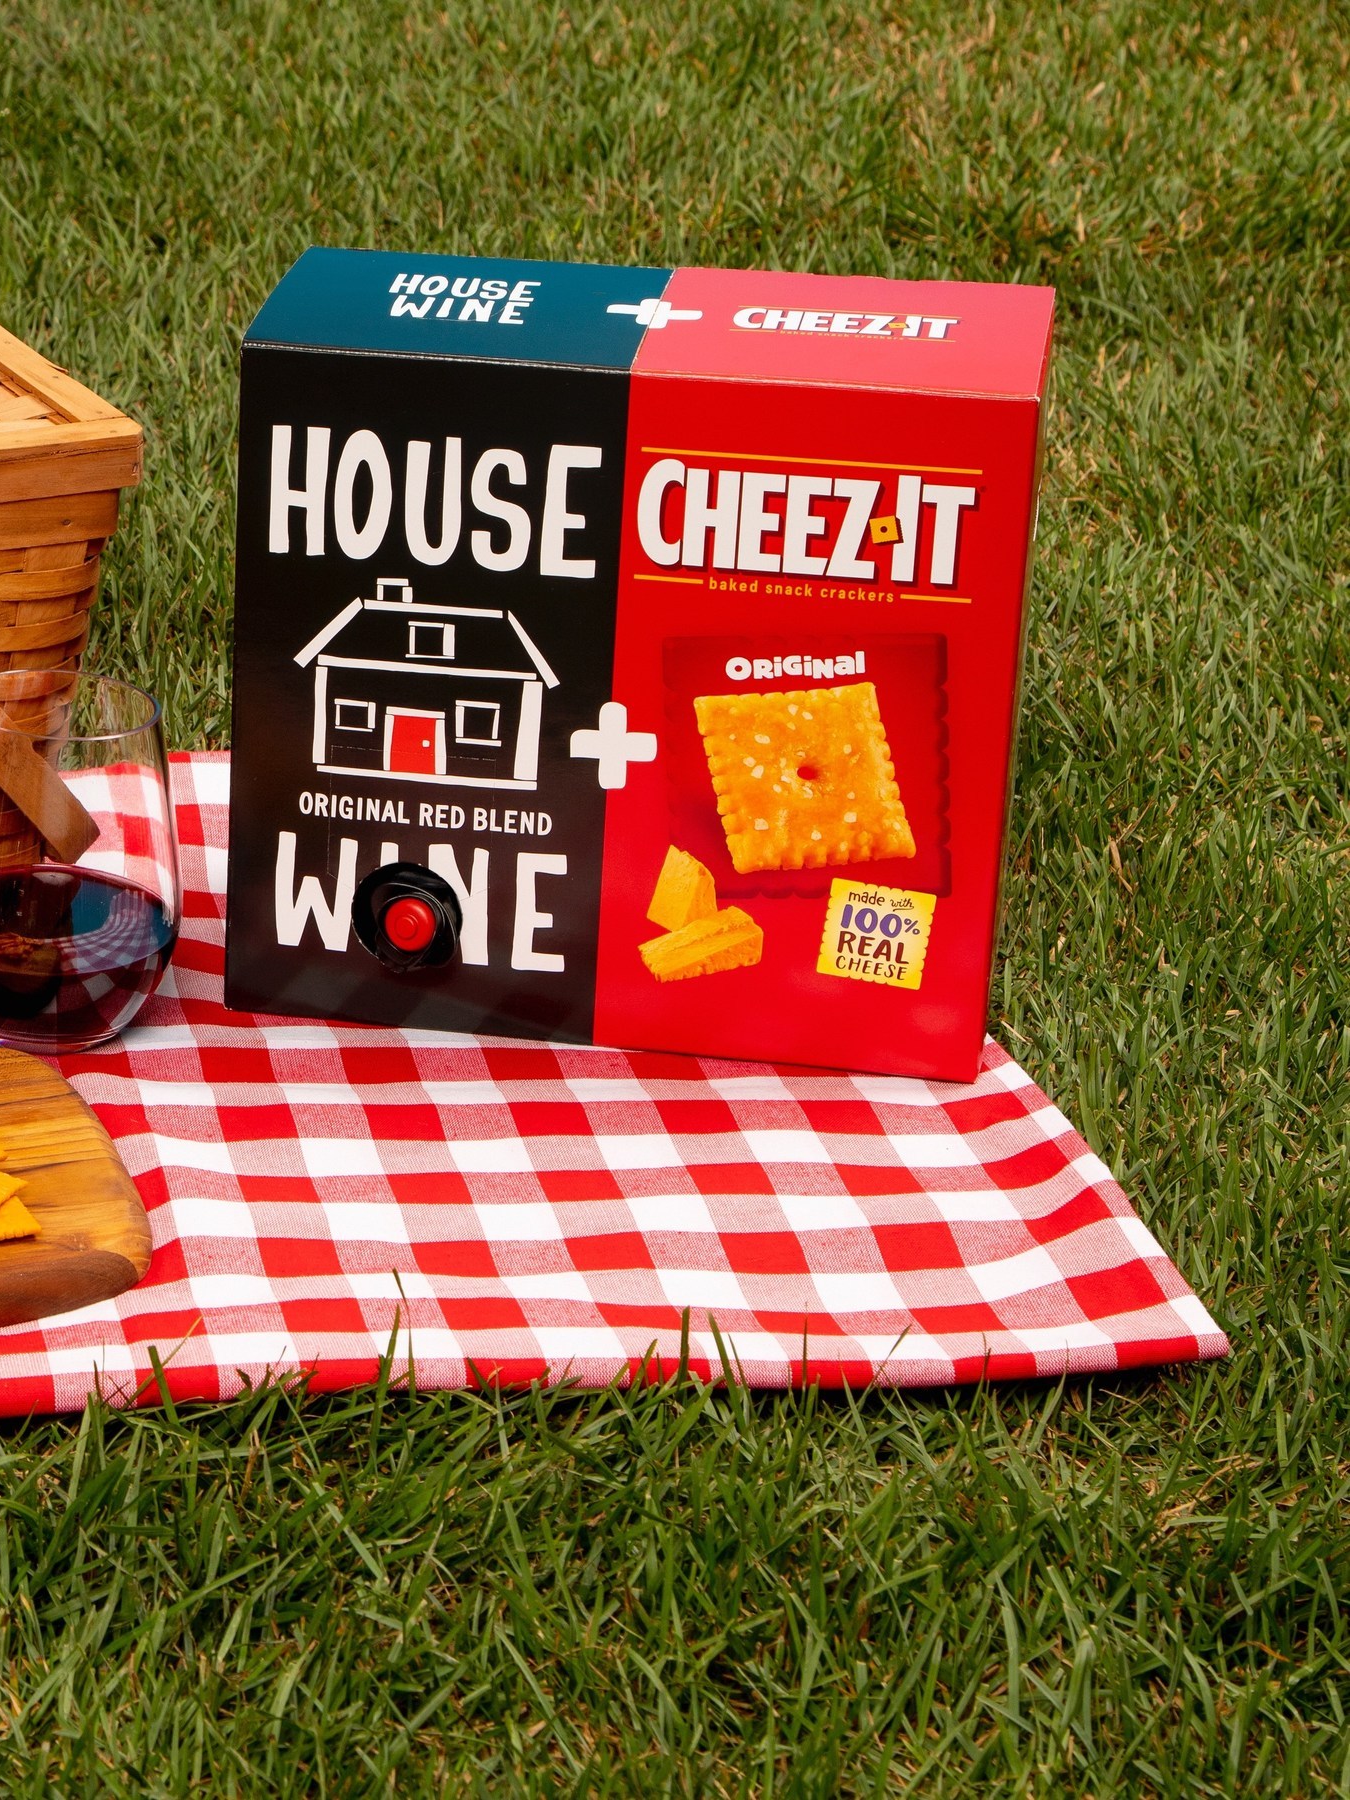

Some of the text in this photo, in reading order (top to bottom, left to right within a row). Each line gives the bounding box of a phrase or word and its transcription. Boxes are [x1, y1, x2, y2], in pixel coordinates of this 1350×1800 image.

[388, 273, 542, 302] HOUSE
[389, 295, 530, 325] WINE
[268, 424, 603, 579] HOUSE
[709, 577, 895, 603] baked snack crackers
[298, 791, 553, 836] ORIGINAL RED BLEND
[275, 830, 568, 973] WNE
[848, 891, 914, 911] made with
[840, 904, 920, 938] 100%
[837, 930, 909, 965] REAL
[835, 955, 908, 981] CHEESE
